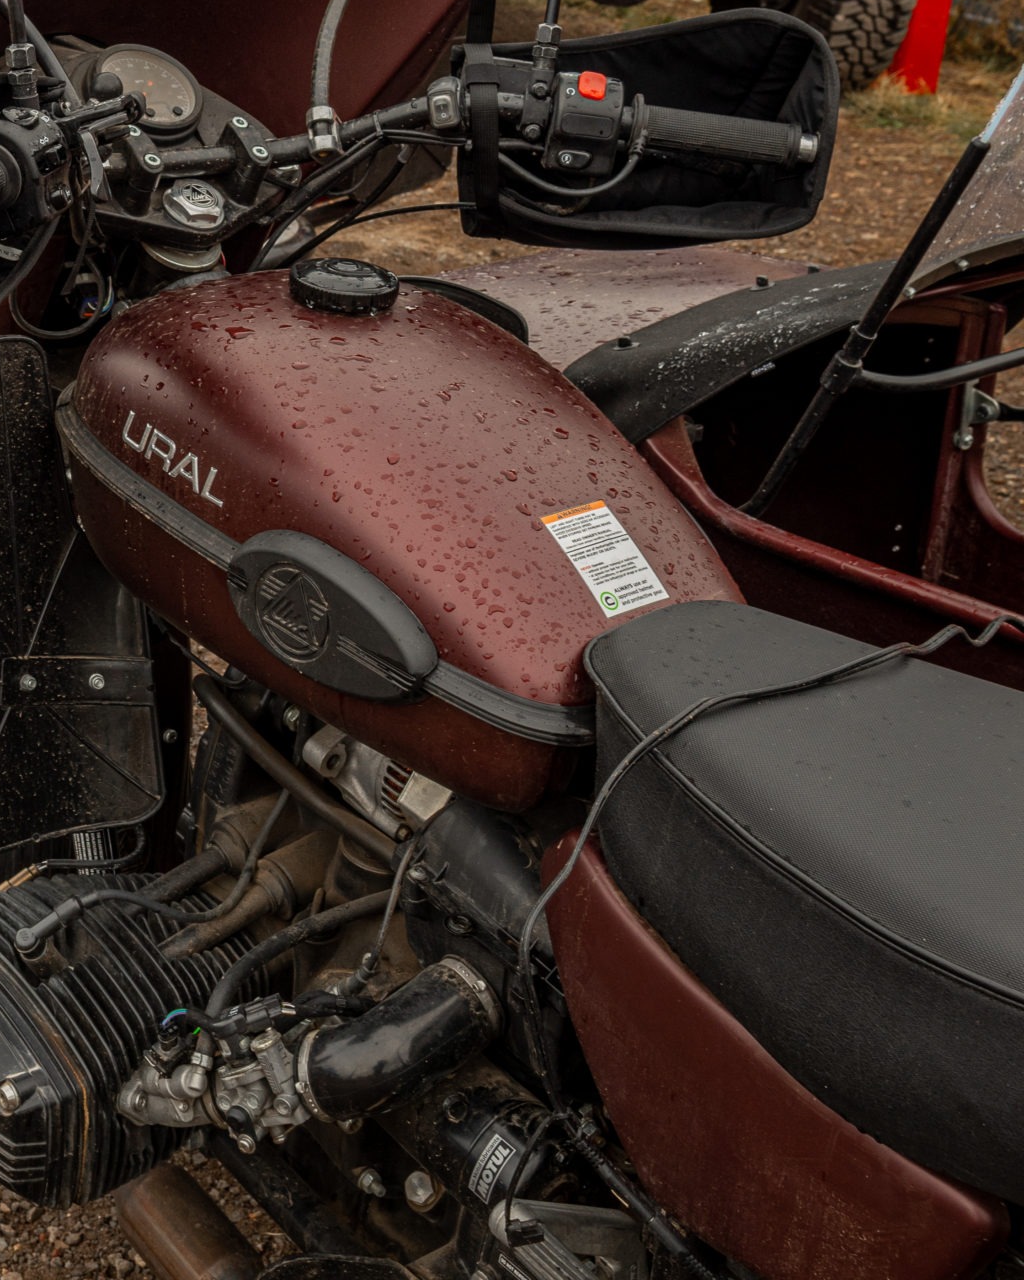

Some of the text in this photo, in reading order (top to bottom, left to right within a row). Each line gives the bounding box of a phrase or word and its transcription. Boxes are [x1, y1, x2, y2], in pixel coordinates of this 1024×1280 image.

[122, 410, 224, 508] URAL
[615, 584, 633, 592] ALWAYS
[631, 593, 653, 603] protective
[476, 1144, 512, 1199] MOTUL
